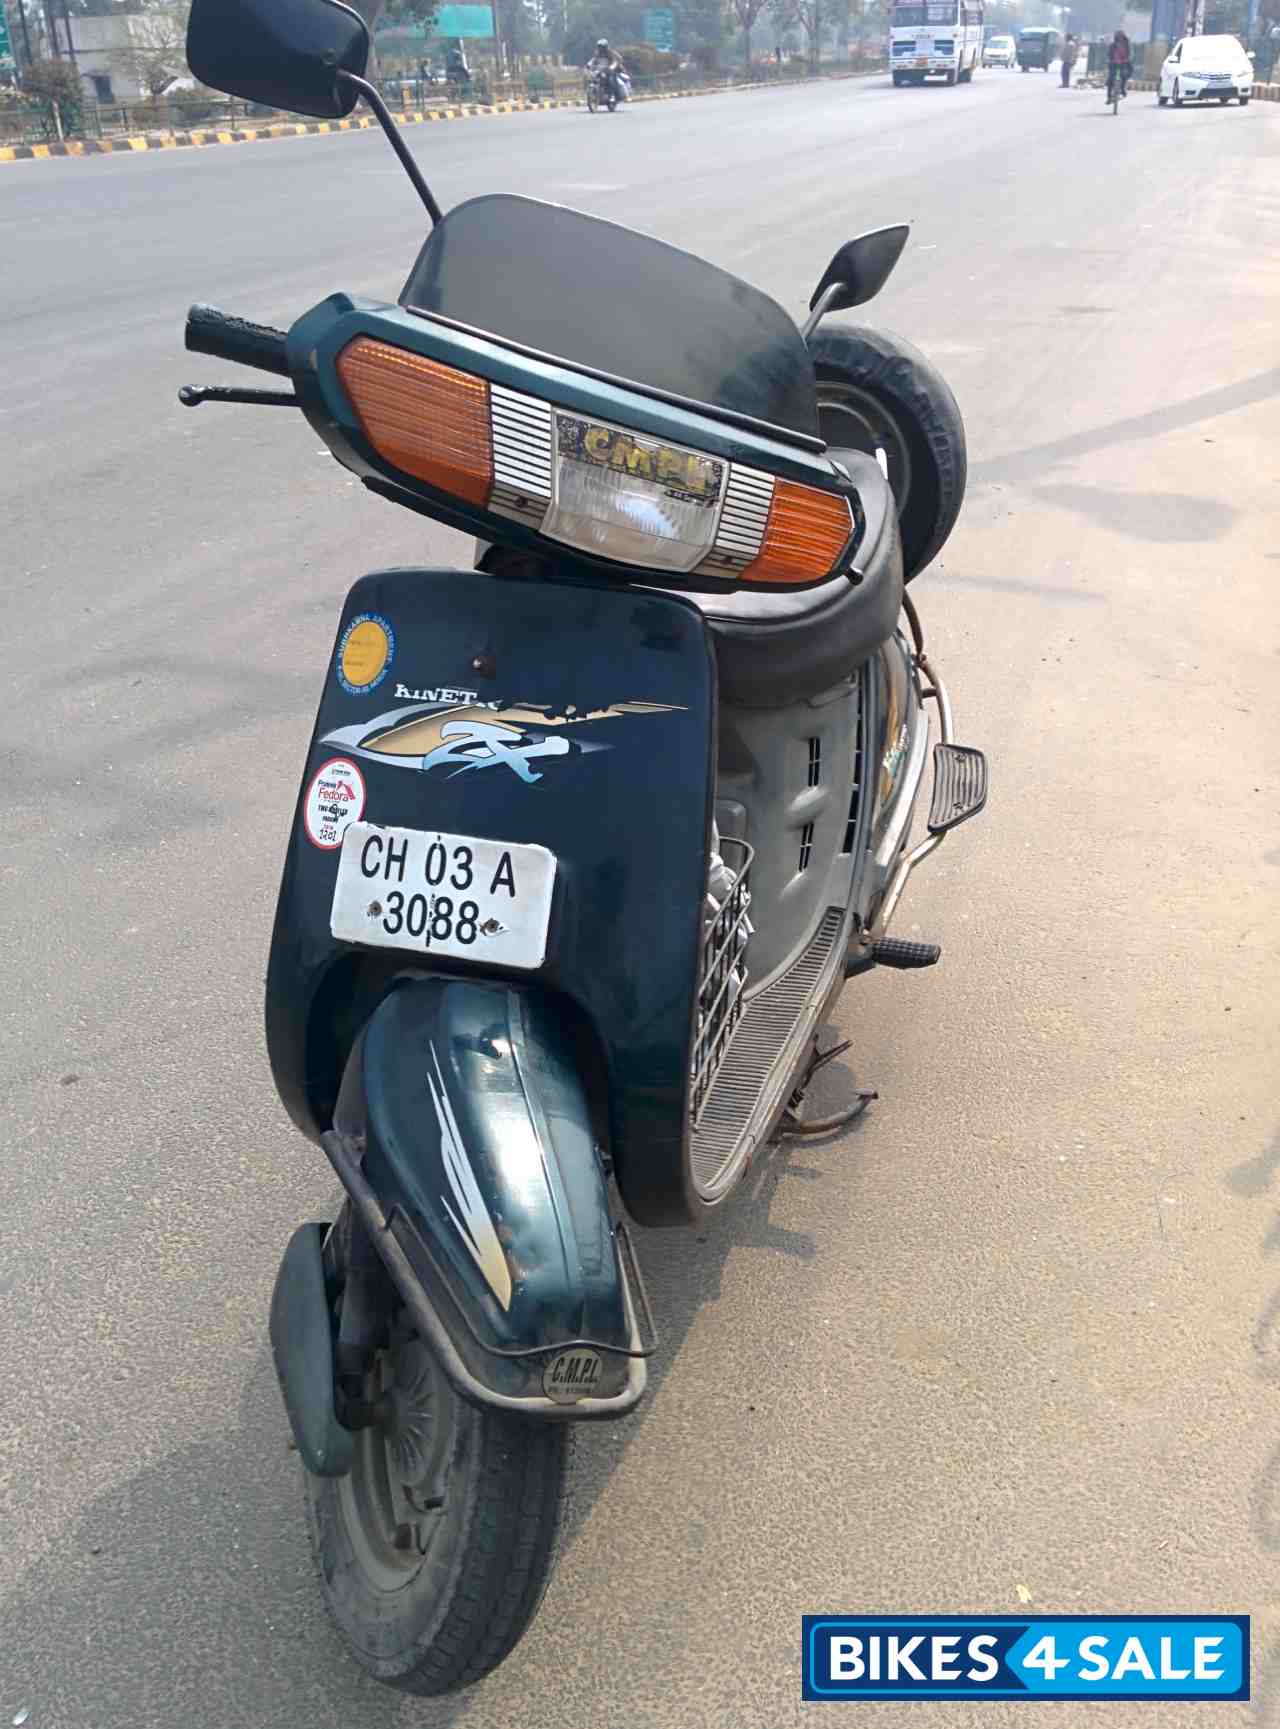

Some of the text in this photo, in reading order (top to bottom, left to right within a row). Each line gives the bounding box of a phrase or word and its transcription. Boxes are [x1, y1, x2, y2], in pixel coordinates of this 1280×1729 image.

[361, 834, 516, 898] CH 03 A
[382, 890, 481, 945] 3088
